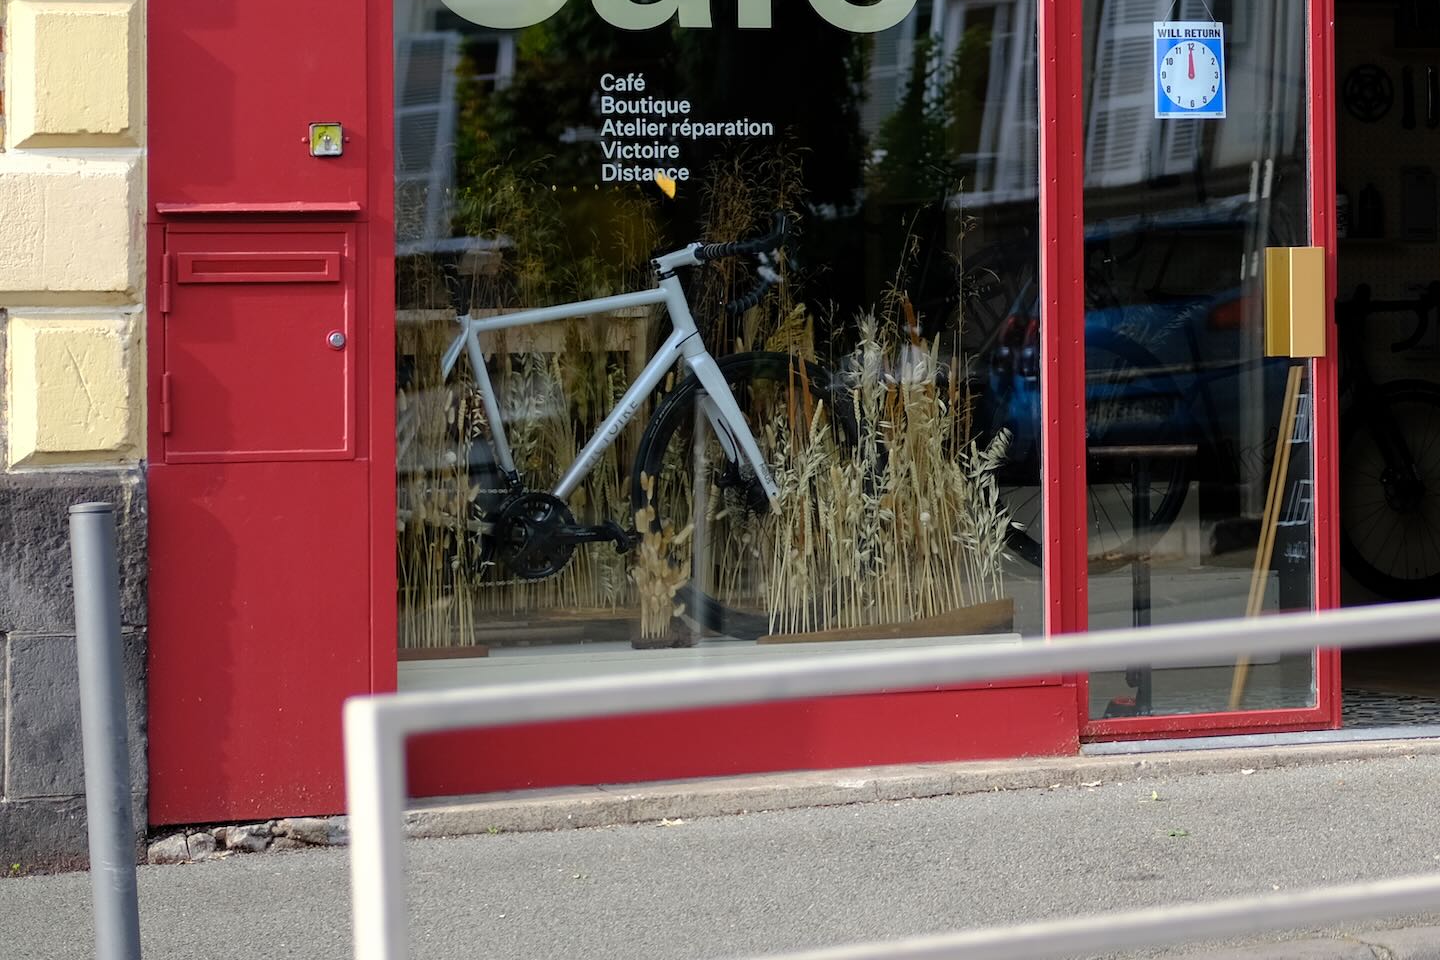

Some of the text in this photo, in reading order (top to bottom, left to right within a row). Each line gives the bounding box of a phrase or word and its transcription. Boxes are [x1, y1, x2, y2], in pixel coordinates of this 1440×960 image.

[1157, 28, 1221, 38] WILL RETURN
[1175, 47, 1182, 55] 11
[1187, 43, 1195, 51] 12
[1202, 47, 1205, 55] 1
[1165, 57, 1174, 66] 10
[1211, 57, 1215, 66] 2
[1161, 71, 1167, 79] 9
[1214, 71, 1219, 79] 3
[600, 73, 646, 91] Café
[1166, 85, 1171, 93] 8
[1211, 85, 1216, 93] 4
[1177, 96, 1181, 104] 7
[1202, 95, 1207, 104] 5
[601, 96, 691, 117] Boutique
[1190, 100, 1195, 108] 6
[600, 118, 774, 140] Atelier réparation
[600, 141, 680, 159] Victoire
[601, 163, 690, 182] Distance
